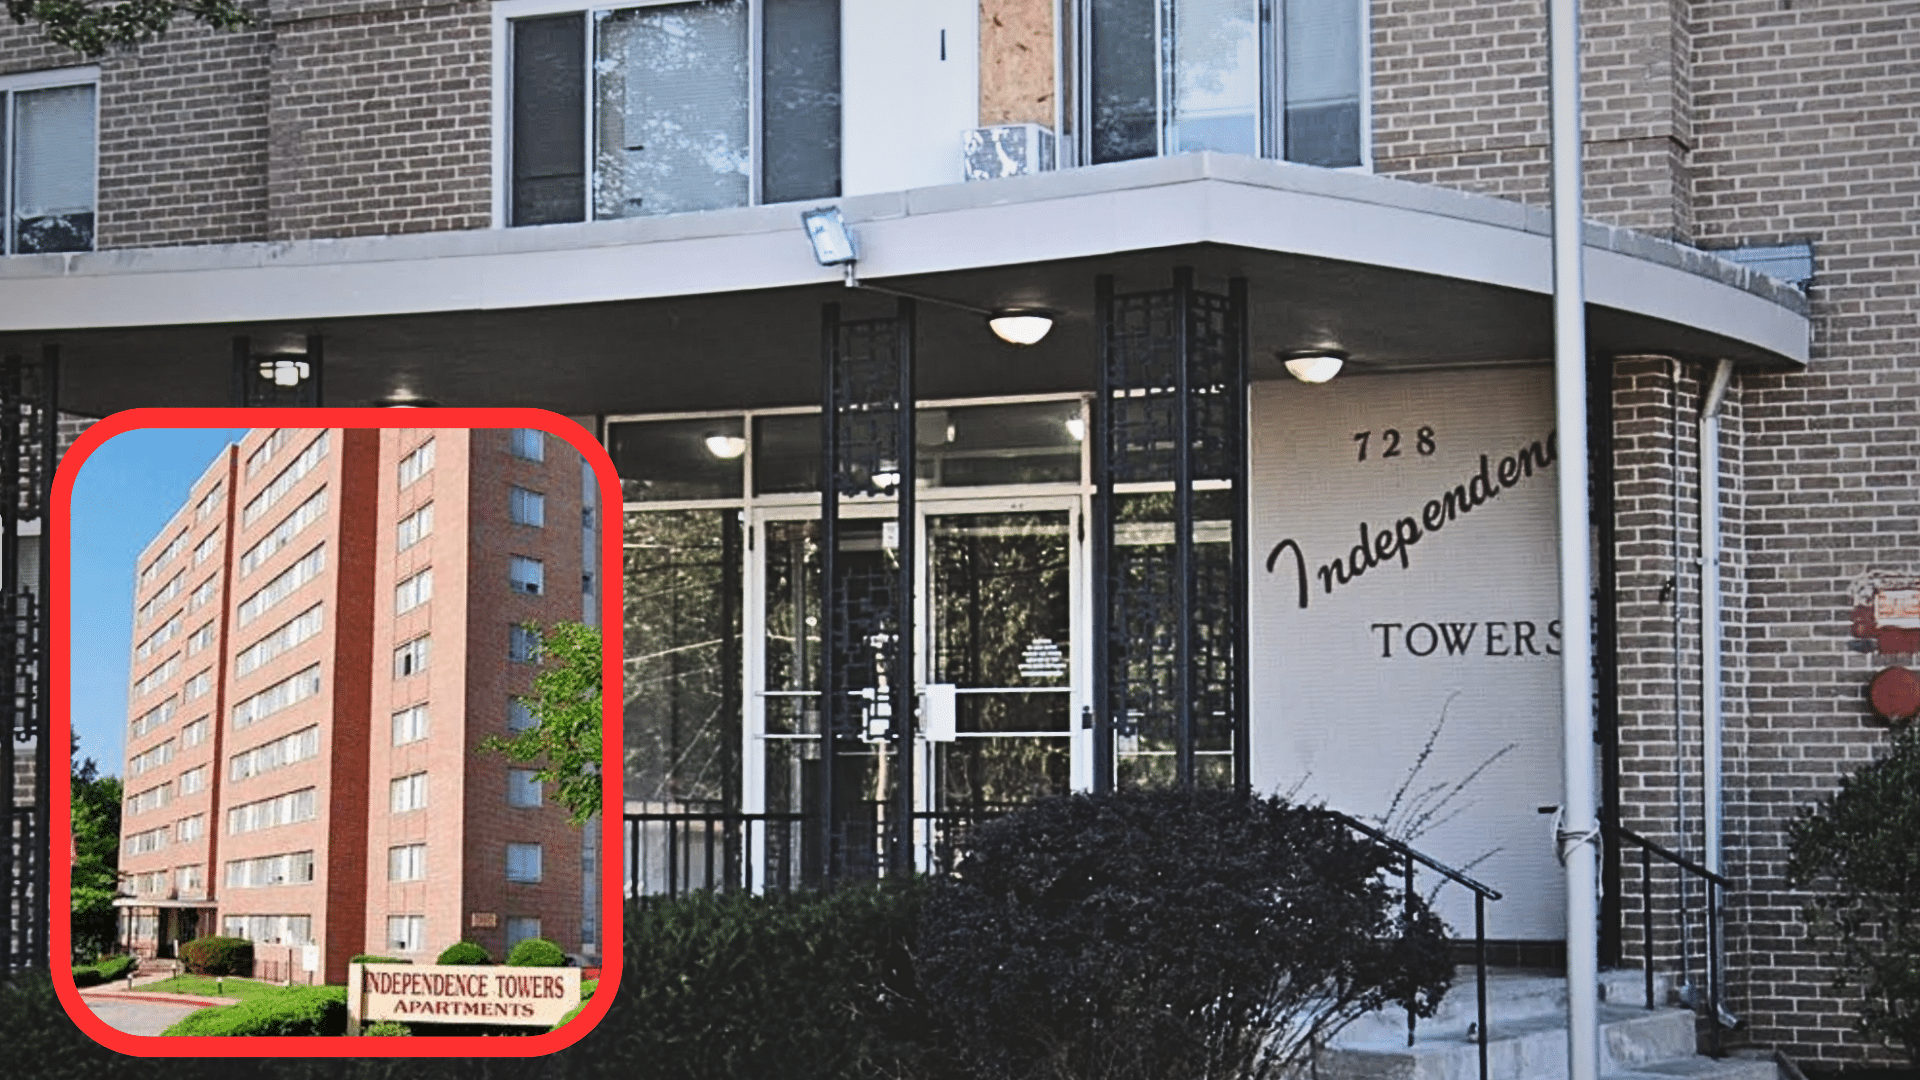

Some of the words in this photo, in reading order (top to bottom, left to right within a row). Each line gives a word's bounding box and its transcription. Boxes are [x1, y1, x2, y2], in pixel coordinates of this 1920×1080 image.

[1353, 426, 1436, 462] 728
[1266, 428, 1558, 609] Independen
[495, 975, 564, 999] TOWERS
[394, 999, 535, 1018] APARTMENTS
